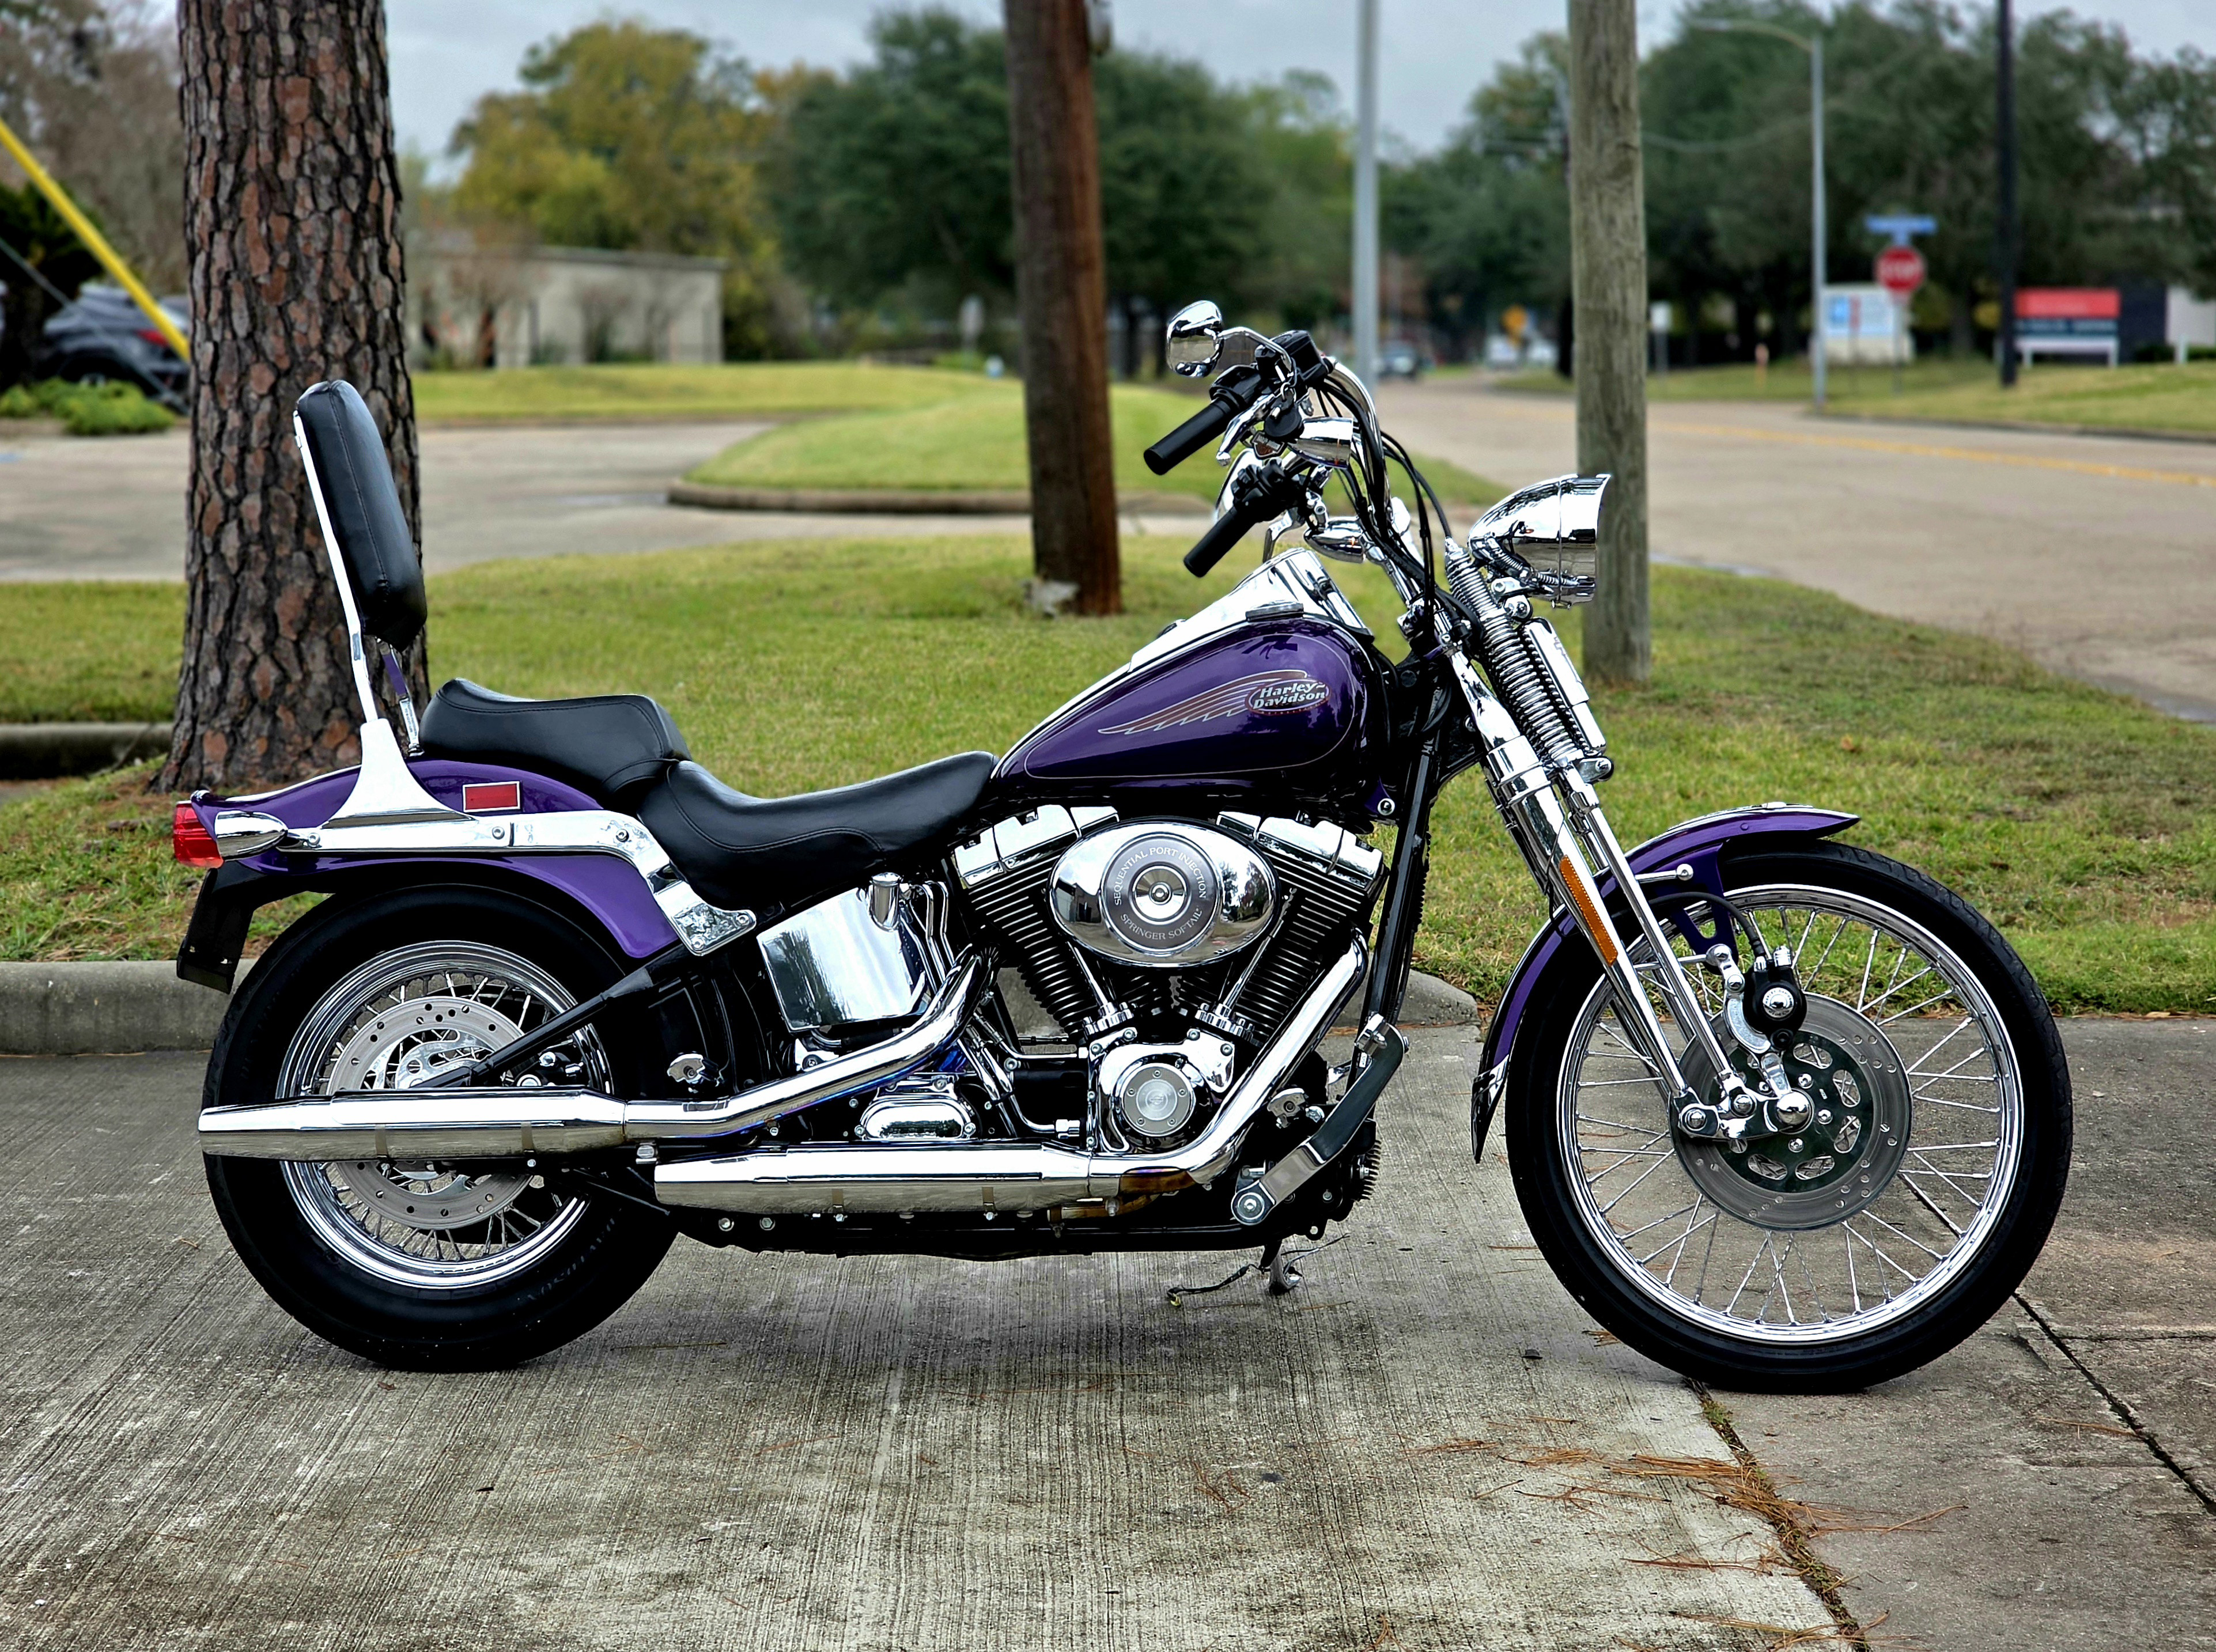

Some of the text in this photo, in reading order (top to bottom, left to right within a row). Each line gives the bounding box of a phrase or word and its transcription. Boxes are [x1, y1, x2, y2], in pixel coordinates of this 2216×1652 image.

[1253, 692, 1325, 709] Davidson
[1114, 847, 1207, 905] SEQUENTIAL PORT INJECTION
[1120, 914, 1166, 940] SPRINGER
